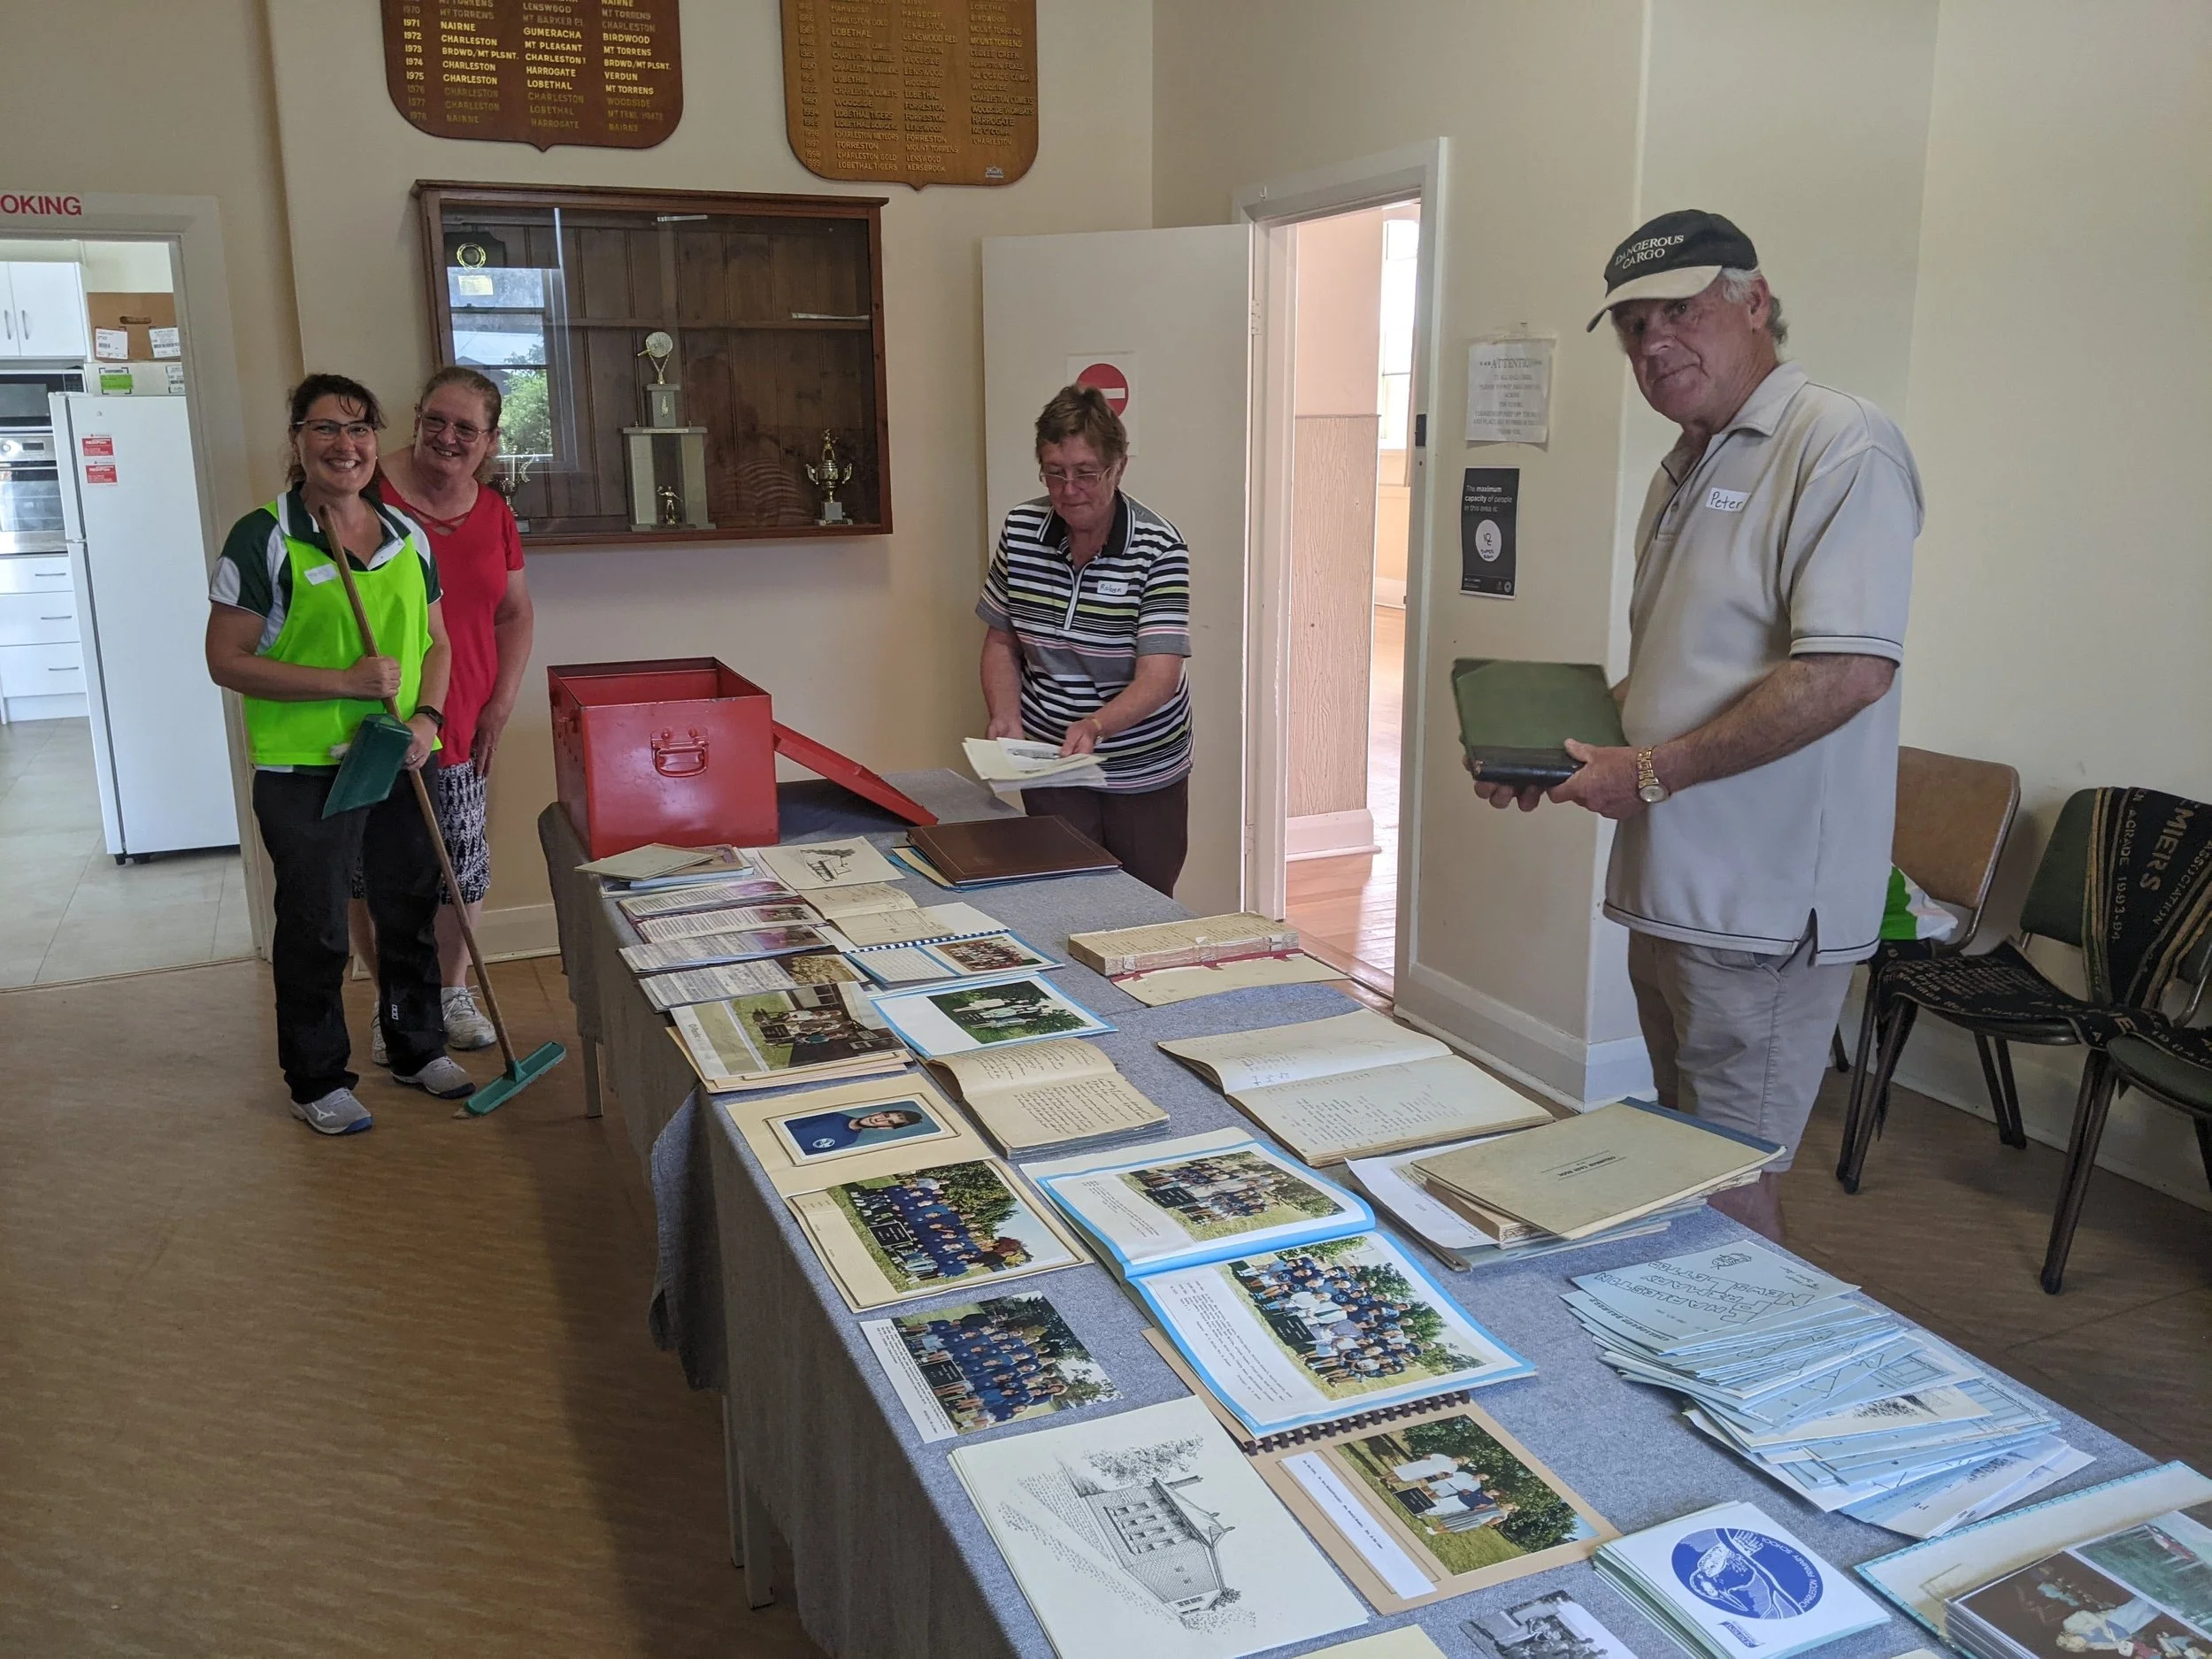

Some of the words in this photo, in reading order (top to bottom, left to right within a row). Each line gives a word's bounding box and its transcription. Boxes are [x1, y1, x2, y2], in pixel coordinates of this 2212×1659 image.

[523, 3, 572, 13] LENSWOOD
[403, 19, 420, 27] 1971
[440, 20, 476, 32] NAIRNE
[403, 31, 423, 41] 1972
[523, 27, 582, 40] GUMERACHA
[832, 27, 872, 38] LOBETHAL
[441, 35, 498, 47] CHARLESTON
[603, 33, 650, 44] BIRDWOOD
[404, 44, 423, 53] 1973
[540, 42, 583, 52] PLEASANT
[617, 46, 652, 57] TORRENS
[405, 57, 424, 66] 1974
[525, 53, 582, 65] CHARLESTON
[442, 60, 496, 72] CHARLESTON
[526, 65, 576, 77] HARROGATE
[406, 71, 425, 81] 1975
[442, 73, 497, 86] CHARLESTON
[603, 72, 638, 81] VERDUN
[527, 80, 573, 91] LOBETHAL
[618, 85, 654, 96] TORRENS
[527, 92, 584, 104] CHARLESTON
[444, 100, 500, 111] CHARLESTON
[530, 104, 575, 115] LOBETHAL
[446, 114, 480, 124] NAIRNE
[834, 109, 870, 119] LOBETHAL
[531, 119, 580, 129] HARROGATE
[905, 134, 947, 143] FORRESTON
[836, 141, 879, 150] FORRESTON
[838, 162, 873, 171] LOBETHAL
[0, 195, 82, 215] OKING
[1615, 234, 1685, 266] DANGEROUS
[1623, 249, 1665, 269] CARGO
[1710, 491, 1743, 510] Peter
[1761, 1536, 1793, 1555] SCHOOL
